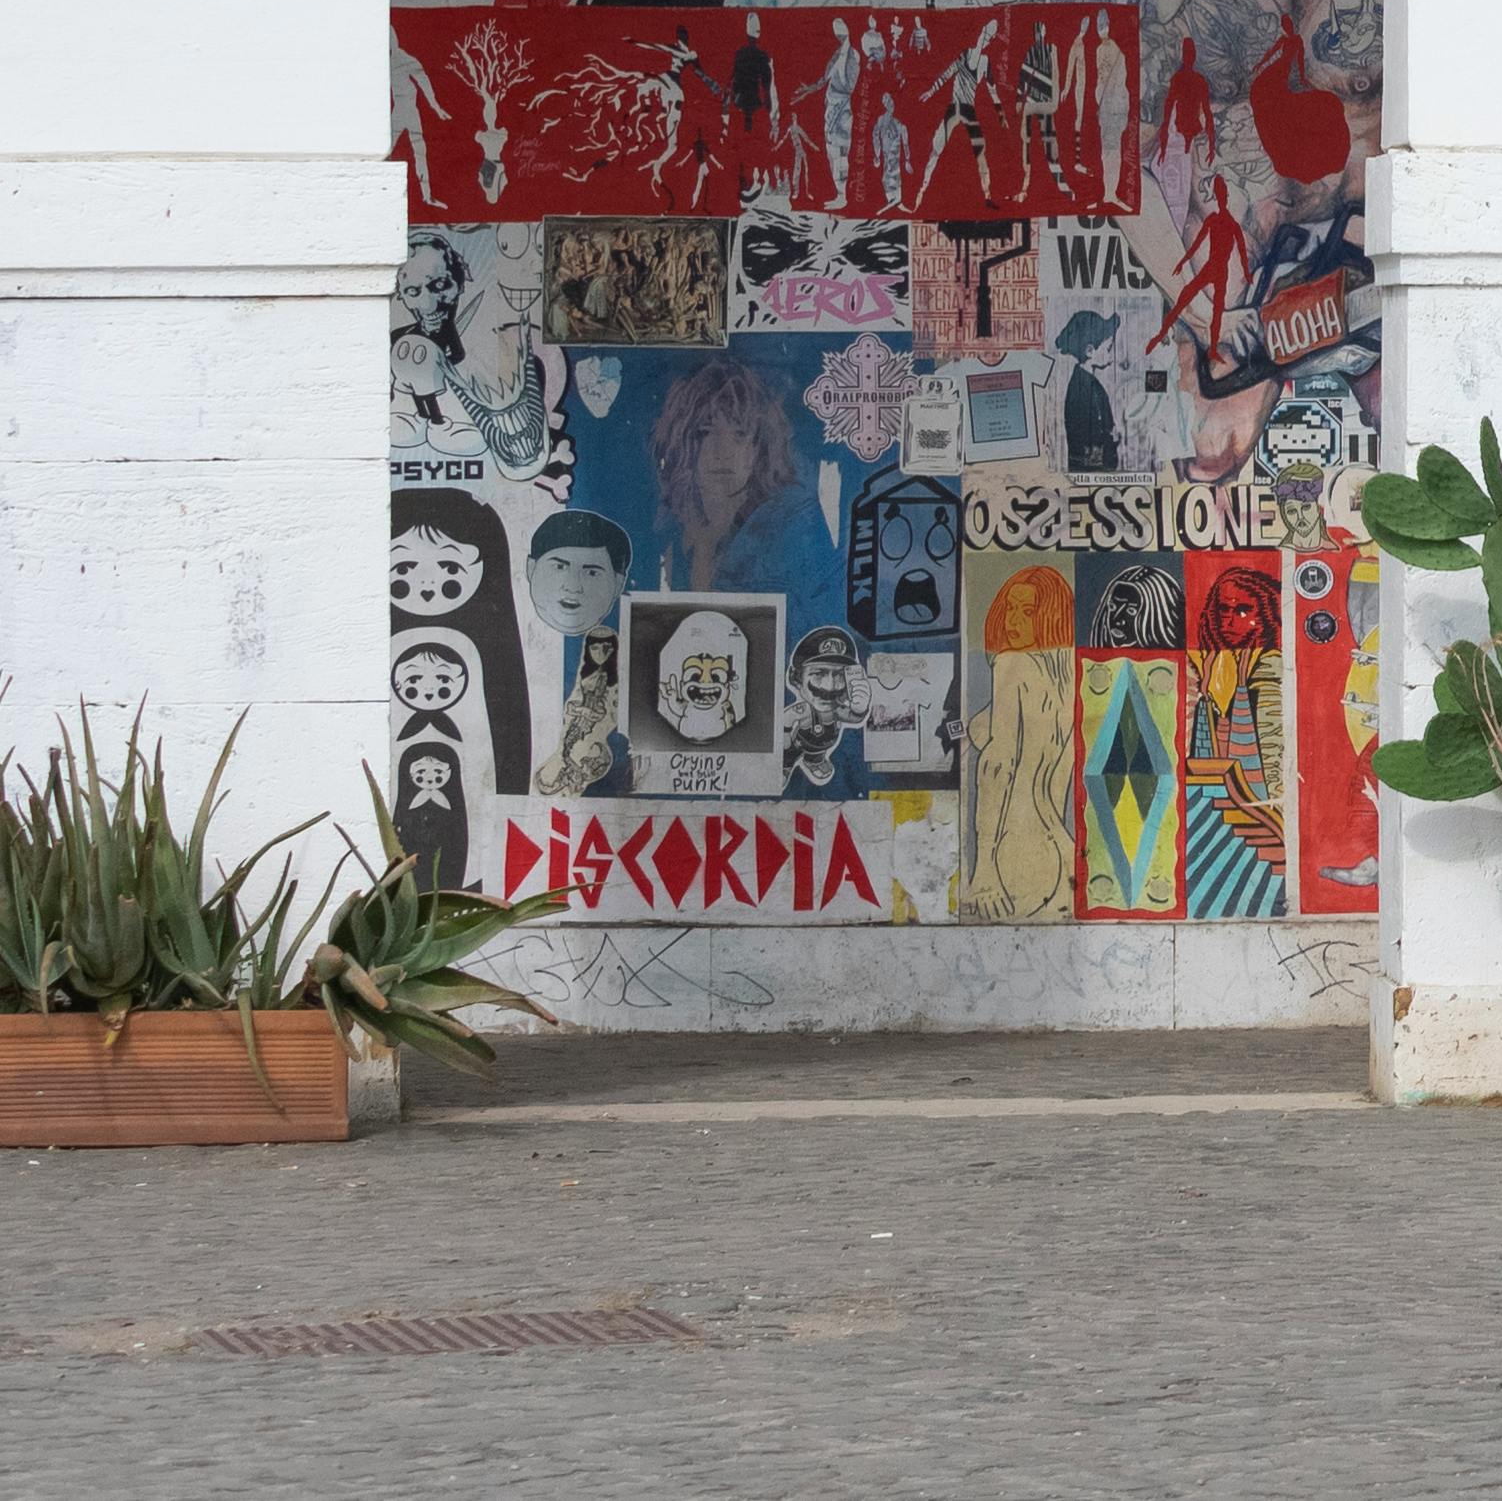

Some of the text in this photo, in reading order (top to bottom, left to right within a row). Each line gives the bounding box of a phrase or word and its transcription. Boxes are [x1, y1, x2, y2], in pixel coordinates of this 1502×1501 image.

[1057, 234, 1153, 290] WAS
[1267, 295, 1343, 362] ALOHA
[1094, 473, 1153, 484] consumista
[962, 484, 1283, 551] OSSESSIONE
[853, 519, 873, 605] MILK
[670, 753, 731, 772] Crying
[673, 771, 729, 793] punk!
